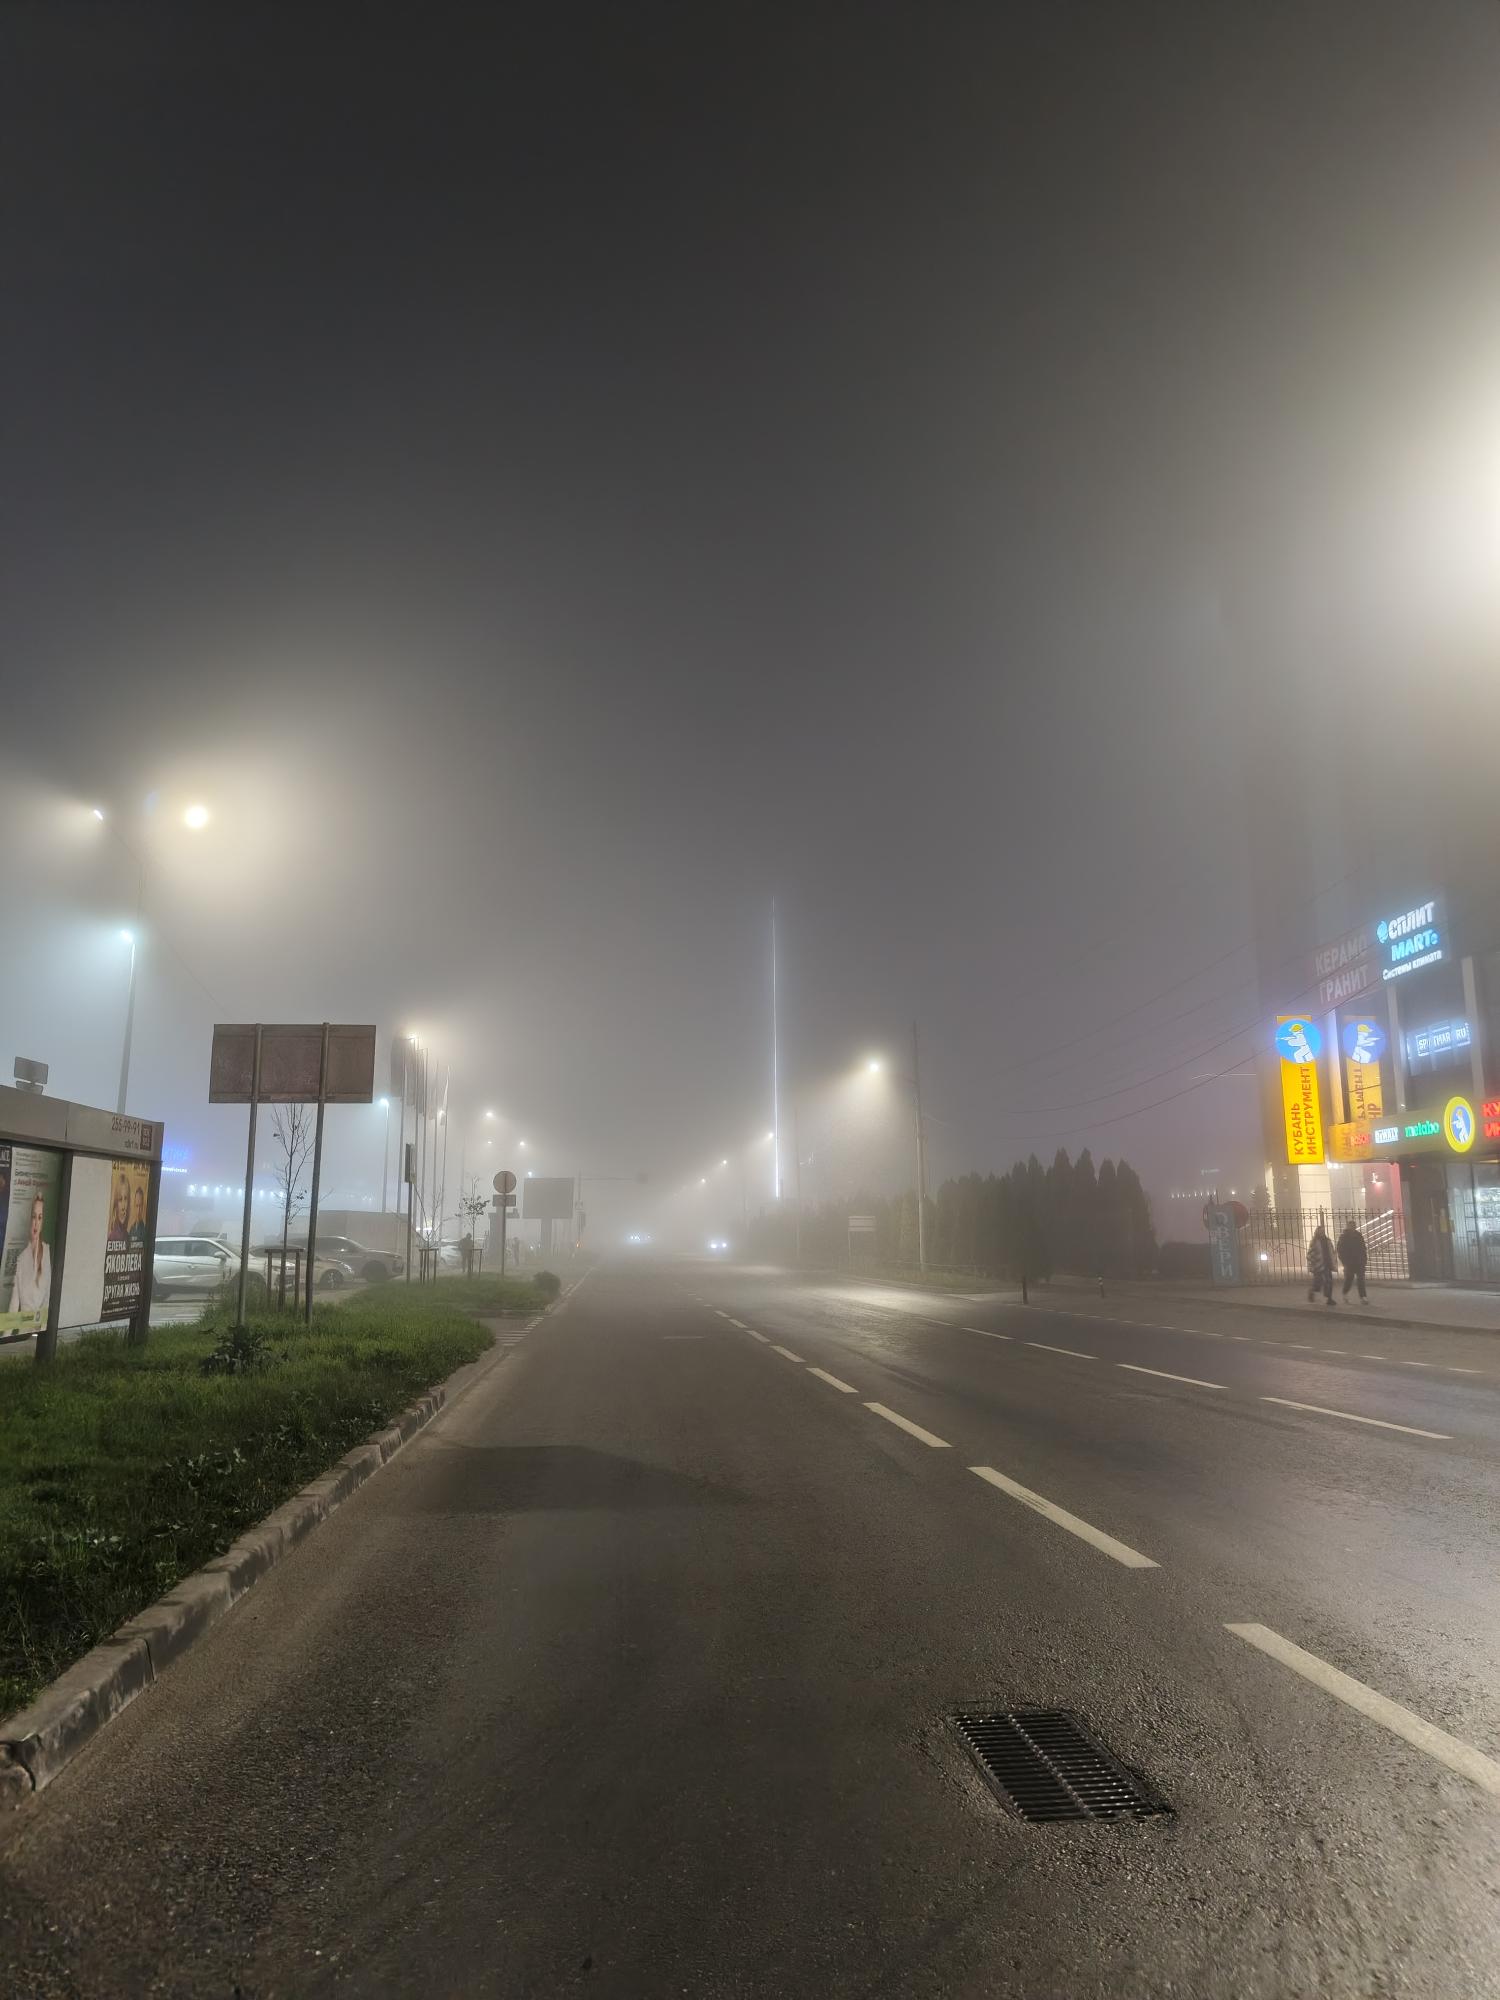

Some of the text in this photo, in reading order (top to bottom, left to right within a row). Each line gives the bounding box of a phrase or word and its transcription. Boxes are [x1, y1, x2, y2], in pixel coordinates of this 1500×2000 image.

[1388, 901, 1435, 940] СПЛИТ
[1382, 950, 1442, 980] Системы климата
[1320, 964, 1369, 1004] ГРАНИТ
[1300, 1066, 1317, 1156] ИНСТРУМЕНТ
[1292, 1102, 1304, 1156] КУБАНЬ
[1405, 1121, 1440, 1137] metabo
[107, 1240, 127, 1252] ЕЛЕНА
[105, 1253, 142, 1274] ЯКОВЛЕВА
[103, 1282, 140, 1302] ДРУГАЯ ЖИЗНЬ
